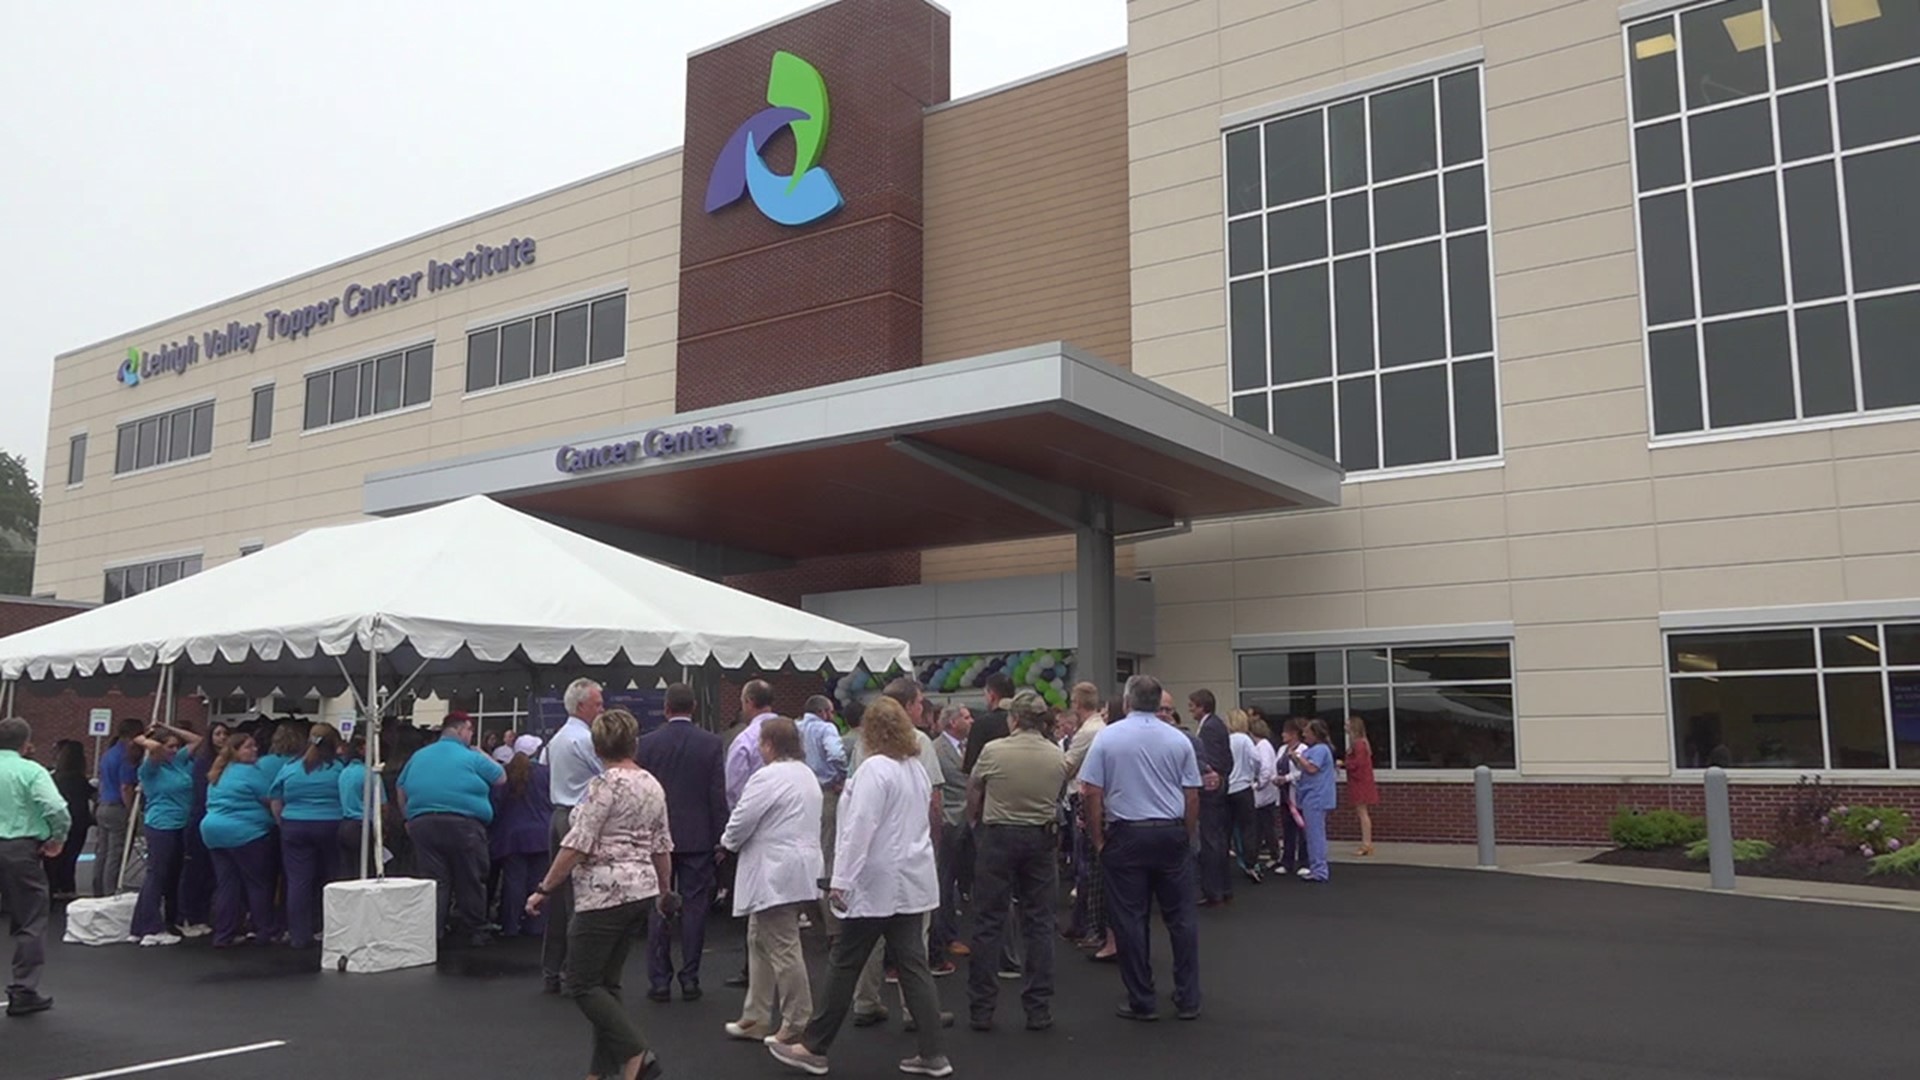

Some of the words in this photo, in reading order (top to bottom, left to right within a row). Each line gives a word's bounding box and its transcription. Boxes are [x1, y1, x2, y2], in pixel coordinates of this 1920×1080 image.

[141, 336, 199, 377] Lehigh
[203, 321, 261, 359] Valley
[265, 297, 339, 340] Topper
[342, 272, 422, 317] Cancer
[428, 237, 536, 291] Institute
[555, 439, 641, 473] Cancer
[643, 423, 733, 458] Center
